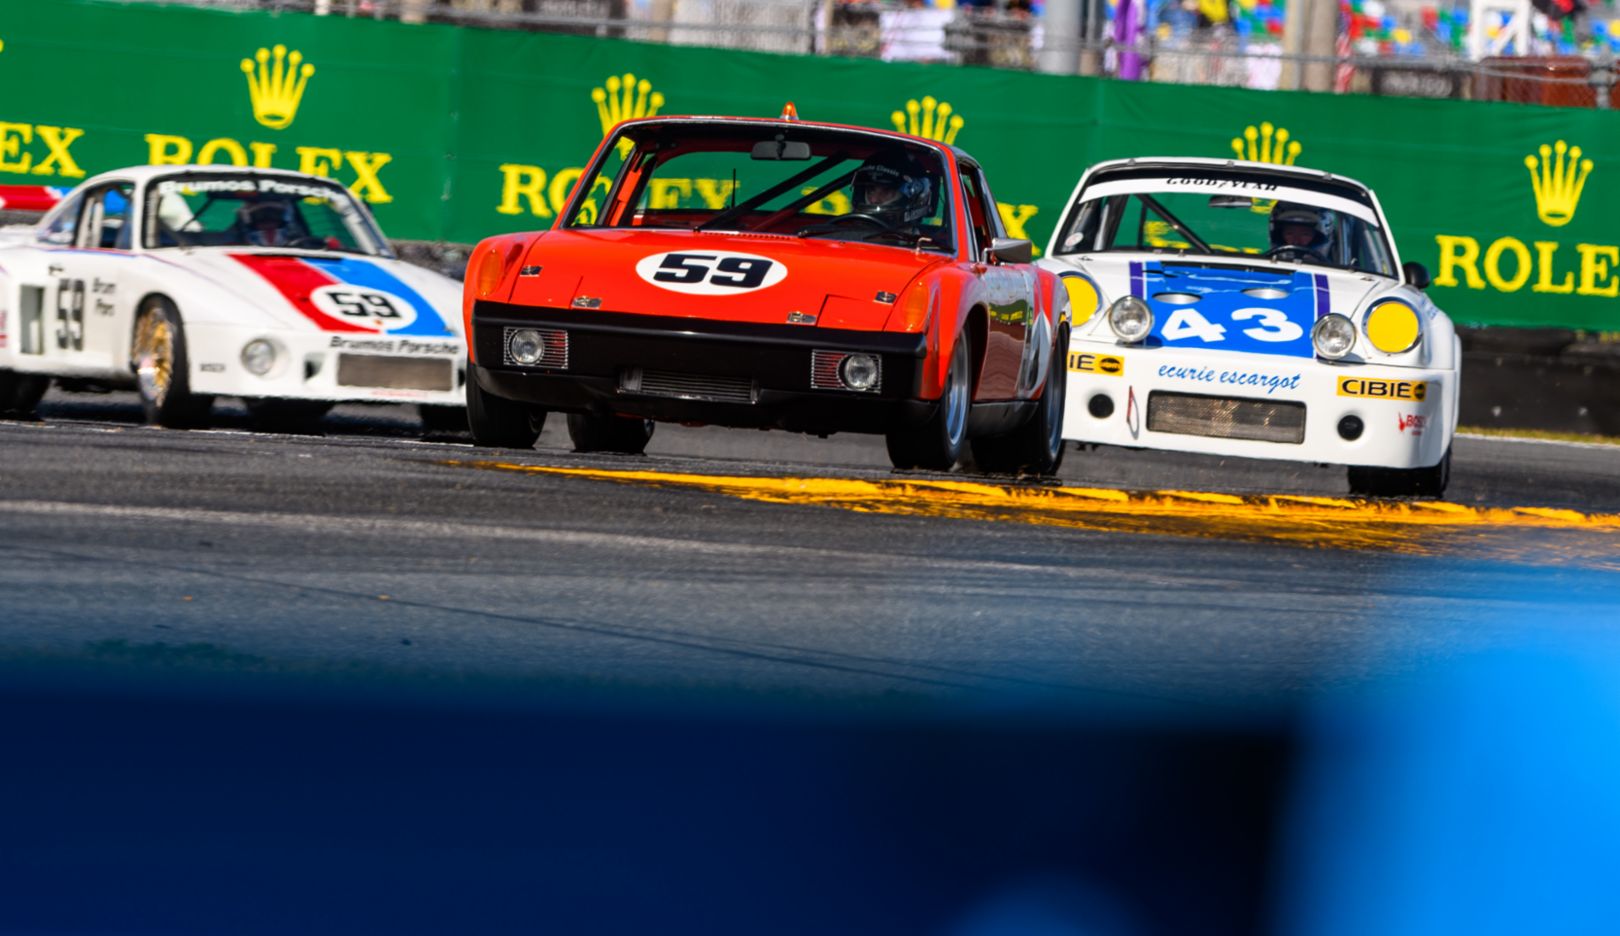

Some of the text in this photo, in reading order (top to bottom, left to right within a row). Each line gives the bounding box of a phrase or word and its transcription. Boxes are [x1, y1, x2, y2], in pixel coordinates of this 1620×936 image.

[158, 179, 346, 204] Brumos Porsch
[653, 253, 773, 288] 59
[57, 279, 85, 351] 59
[326, 292, 401, 318] 59
[1161, 308, 1304, 343] 43
[330, 336, 459, 355] Brumos Porsche
[1158, 363, 1301, 394] ecurie escargot
[1342, 379, 1412, 399] CIBIE
